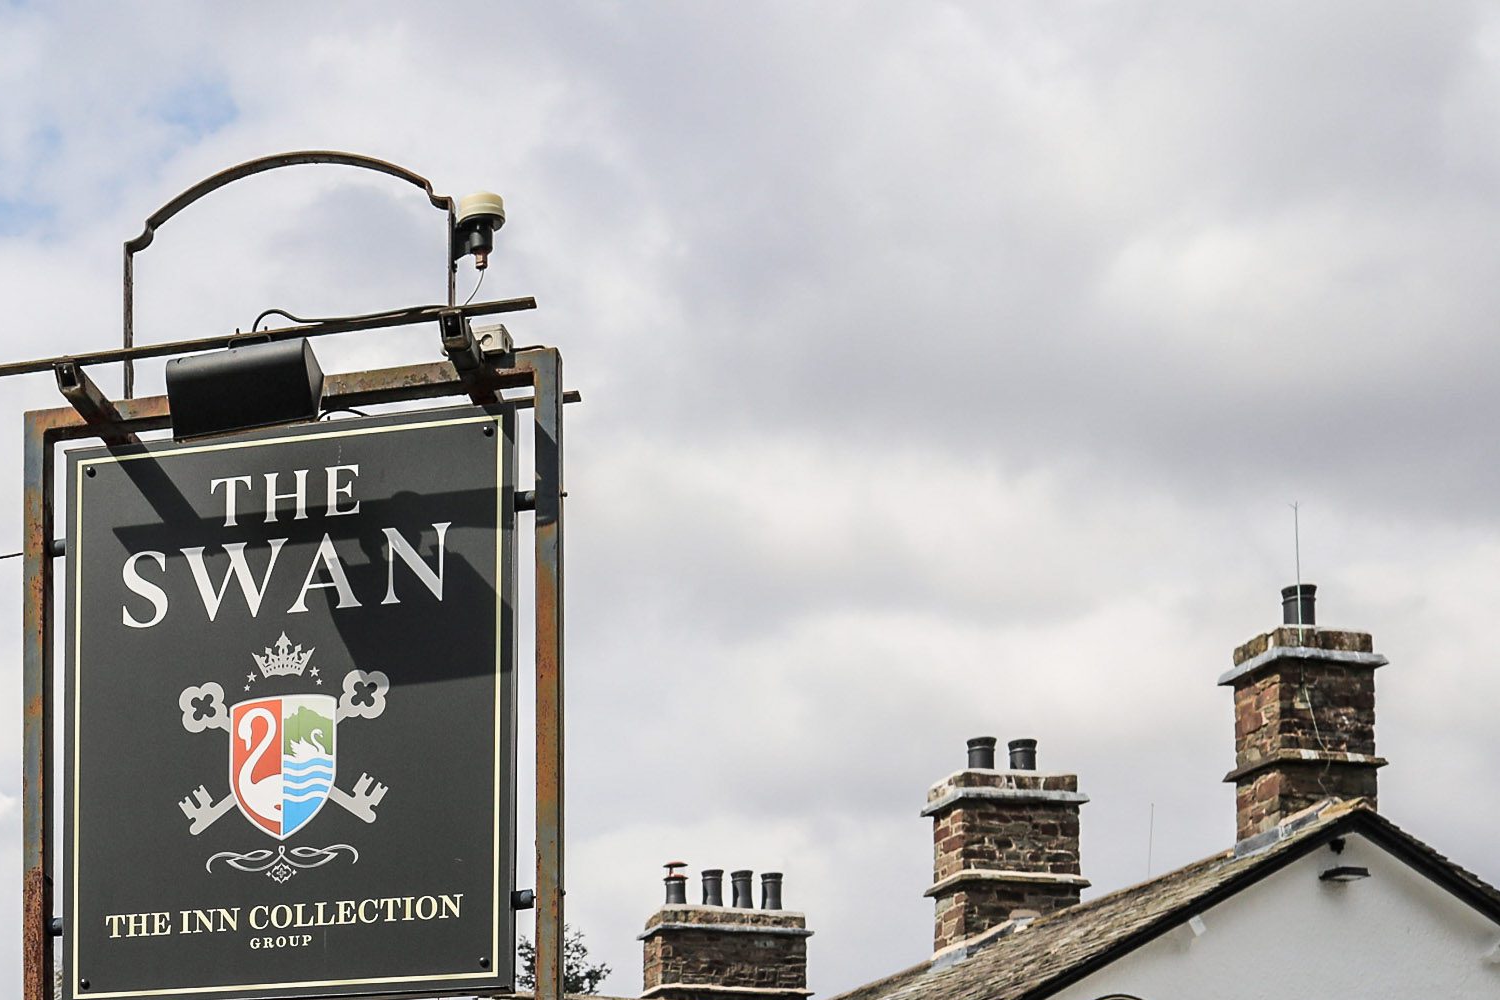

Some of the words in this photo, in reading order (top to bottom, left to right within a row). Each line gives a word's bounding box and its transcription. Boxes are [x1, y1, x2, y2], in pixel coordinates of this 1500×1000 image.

[210, 463, 360, 527] THE
[122, 521, 452, 629] SWAN
[105, 911, 172, 939] THE
[179, 907, 241, 935] INN
[249, 893, 464, 930] COLLECTION
[249, 934, 313, 950] GROUP
